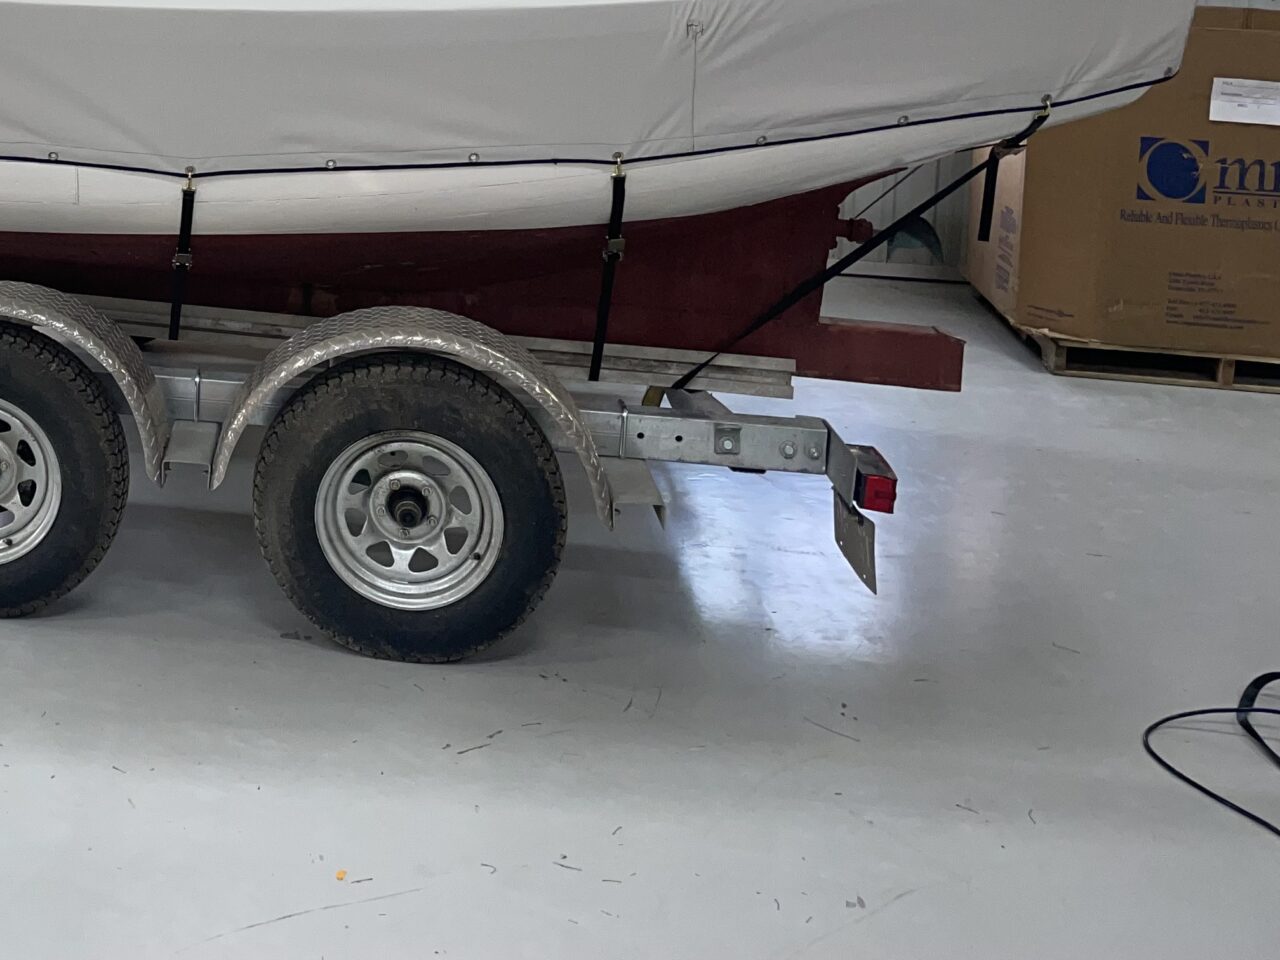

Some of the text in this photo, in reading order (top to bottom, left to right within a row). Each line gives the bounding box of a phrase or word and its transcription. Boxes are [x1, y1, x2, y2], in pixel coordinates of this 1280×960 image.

[1120, 209, 1152, 224] Reliable
[1156, 212, 1173, 225] And
[1175, 212, 1208, 227] Flexible
